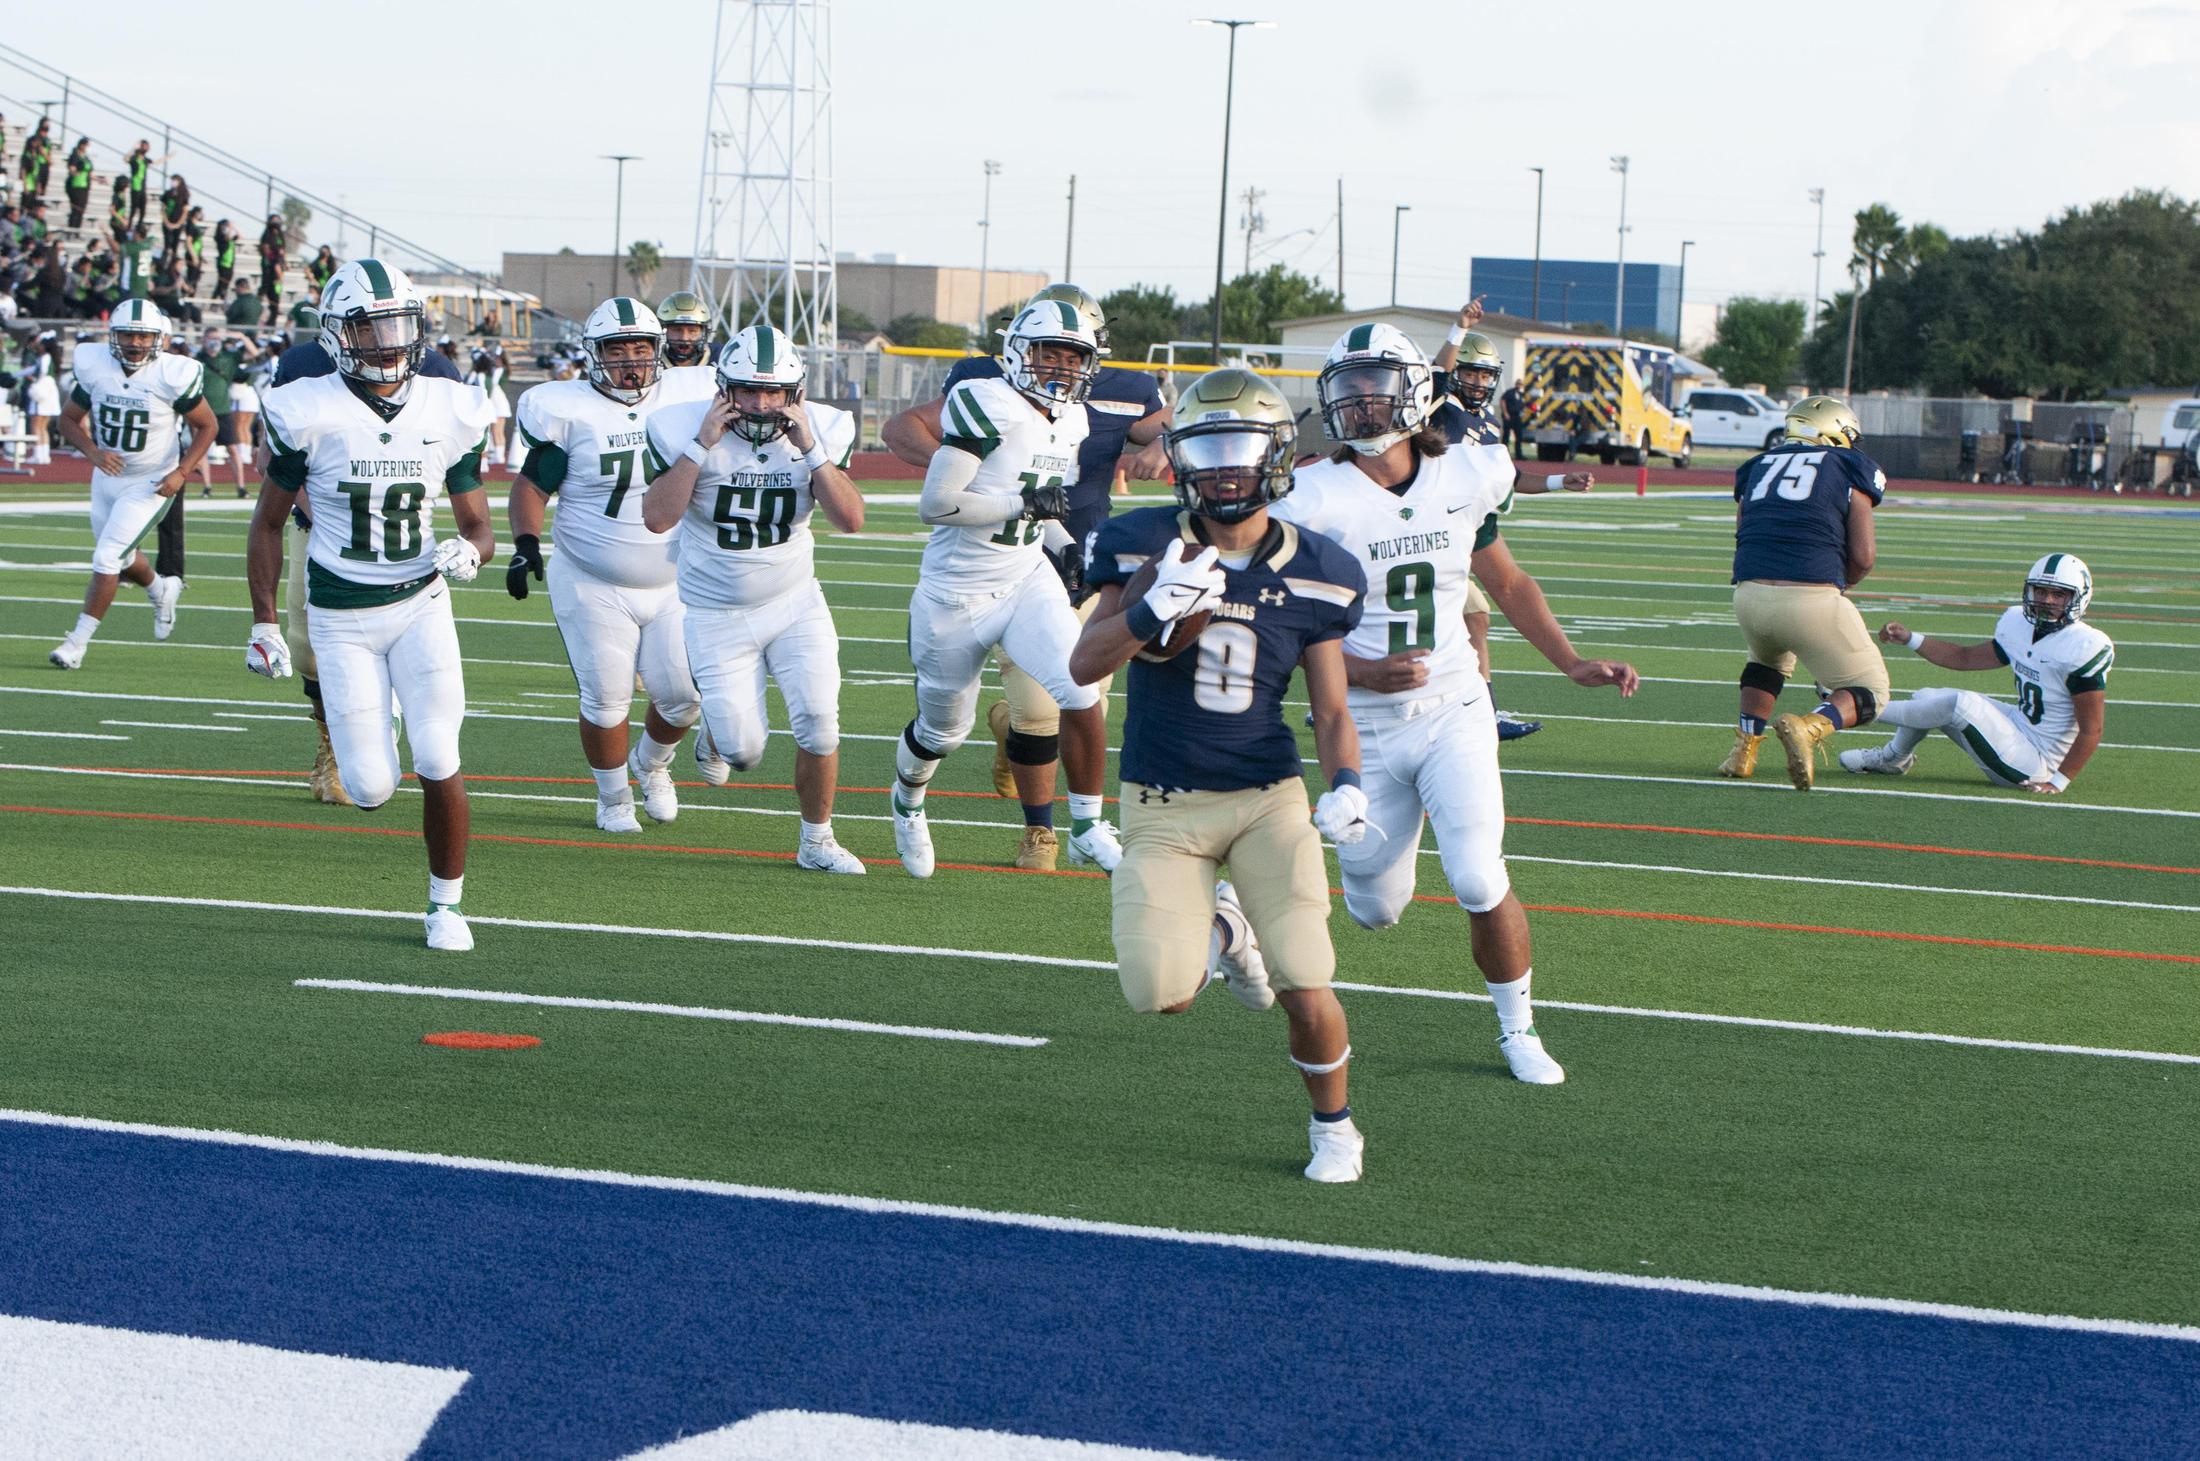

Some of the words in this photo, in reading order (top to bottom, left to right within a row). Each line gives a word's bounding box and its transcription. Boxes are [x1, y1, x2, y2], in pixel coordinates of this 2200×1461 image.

[100, 403, 149, 452] 56
[1205, 411, 1231, 420] PROUD
[350, 460, 423, 477] WOLVERINES
[730, 472, 792, 487] WOLVERINES
[1750, 451, 1828, 502] 75
[337, 481, 426, 562] 18
[713, 485, 797, 550] 50
[1368, 530, 1450, 561] WOLVERINES
[1211, 602, 1256, 621] UGARS
[1385, 561, 1436, 655] 9
[1195, 622, 1257, 713] 8
